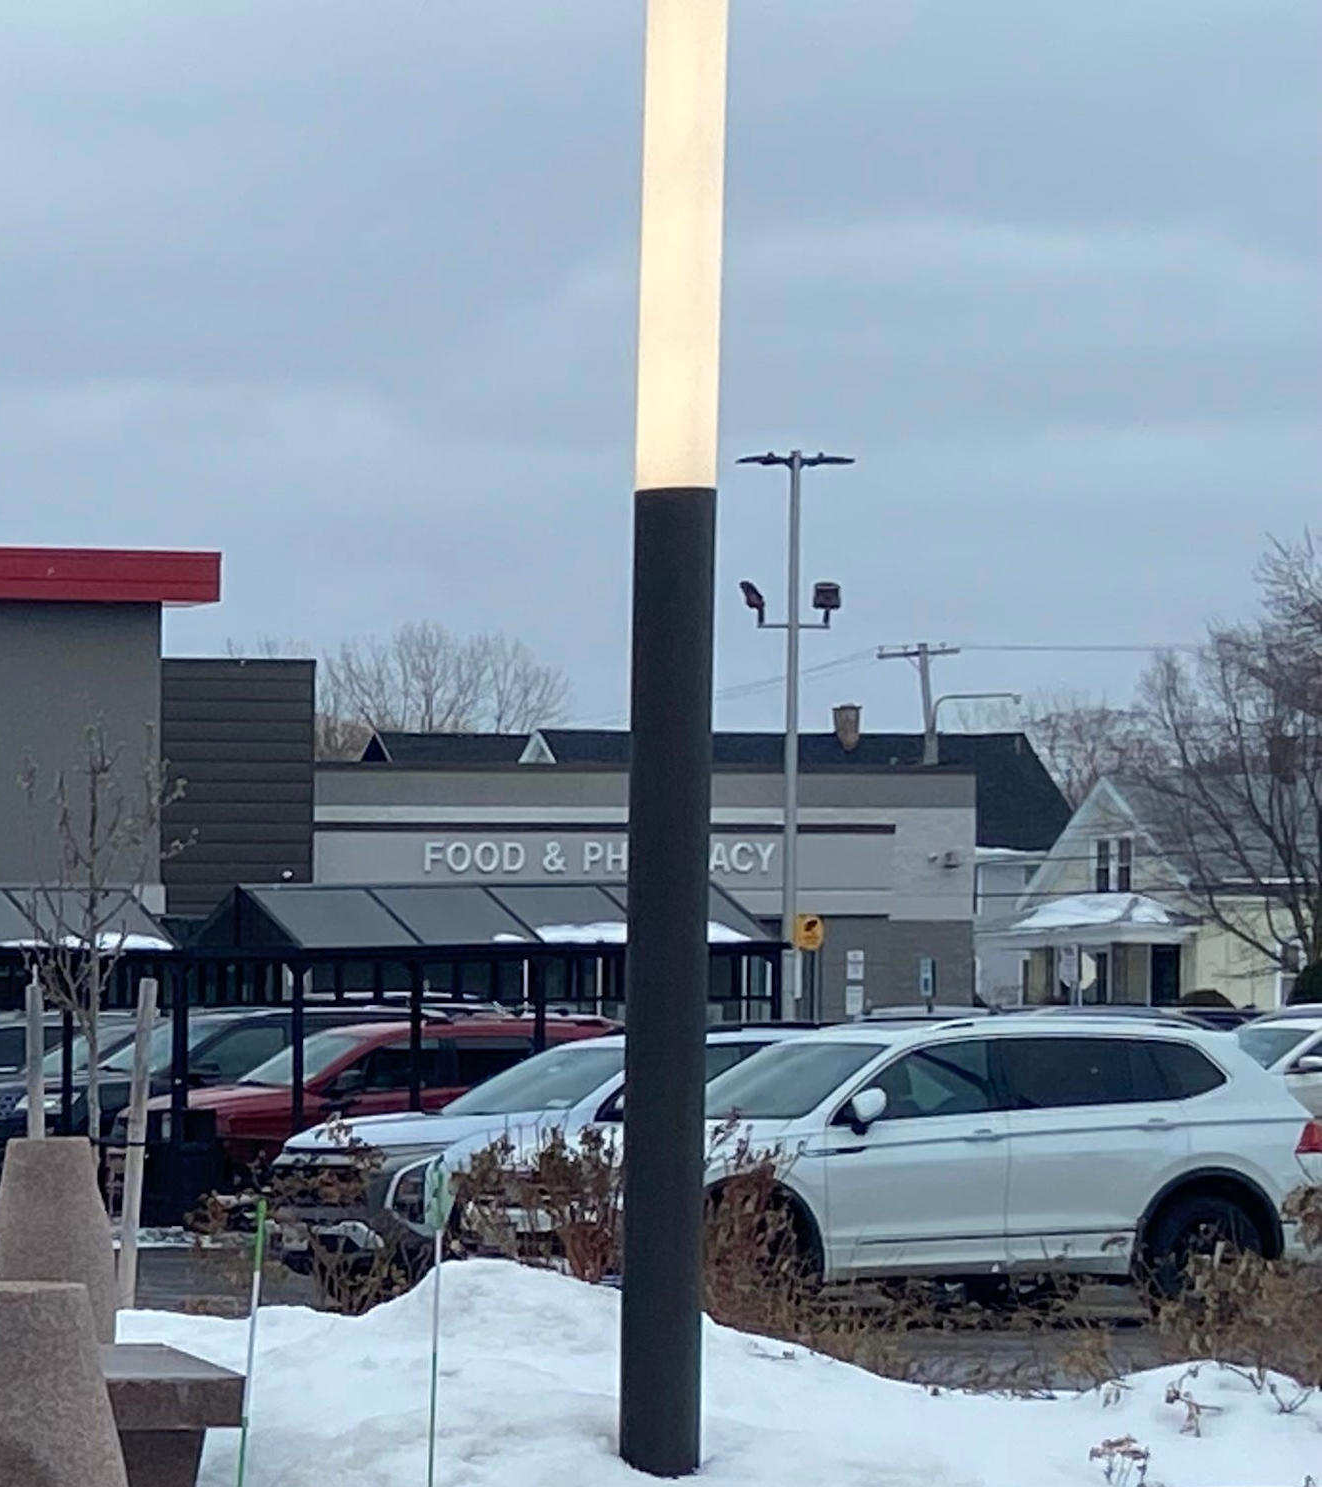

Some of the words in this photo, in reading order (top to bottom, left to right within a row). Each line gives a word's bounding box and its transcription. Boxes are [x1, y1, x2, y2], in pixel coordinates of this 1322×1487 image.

[424, 841, 526, 873] FOOD
[542, 842, 567, 873] &
[582, 841, 776, 874] PHACY
